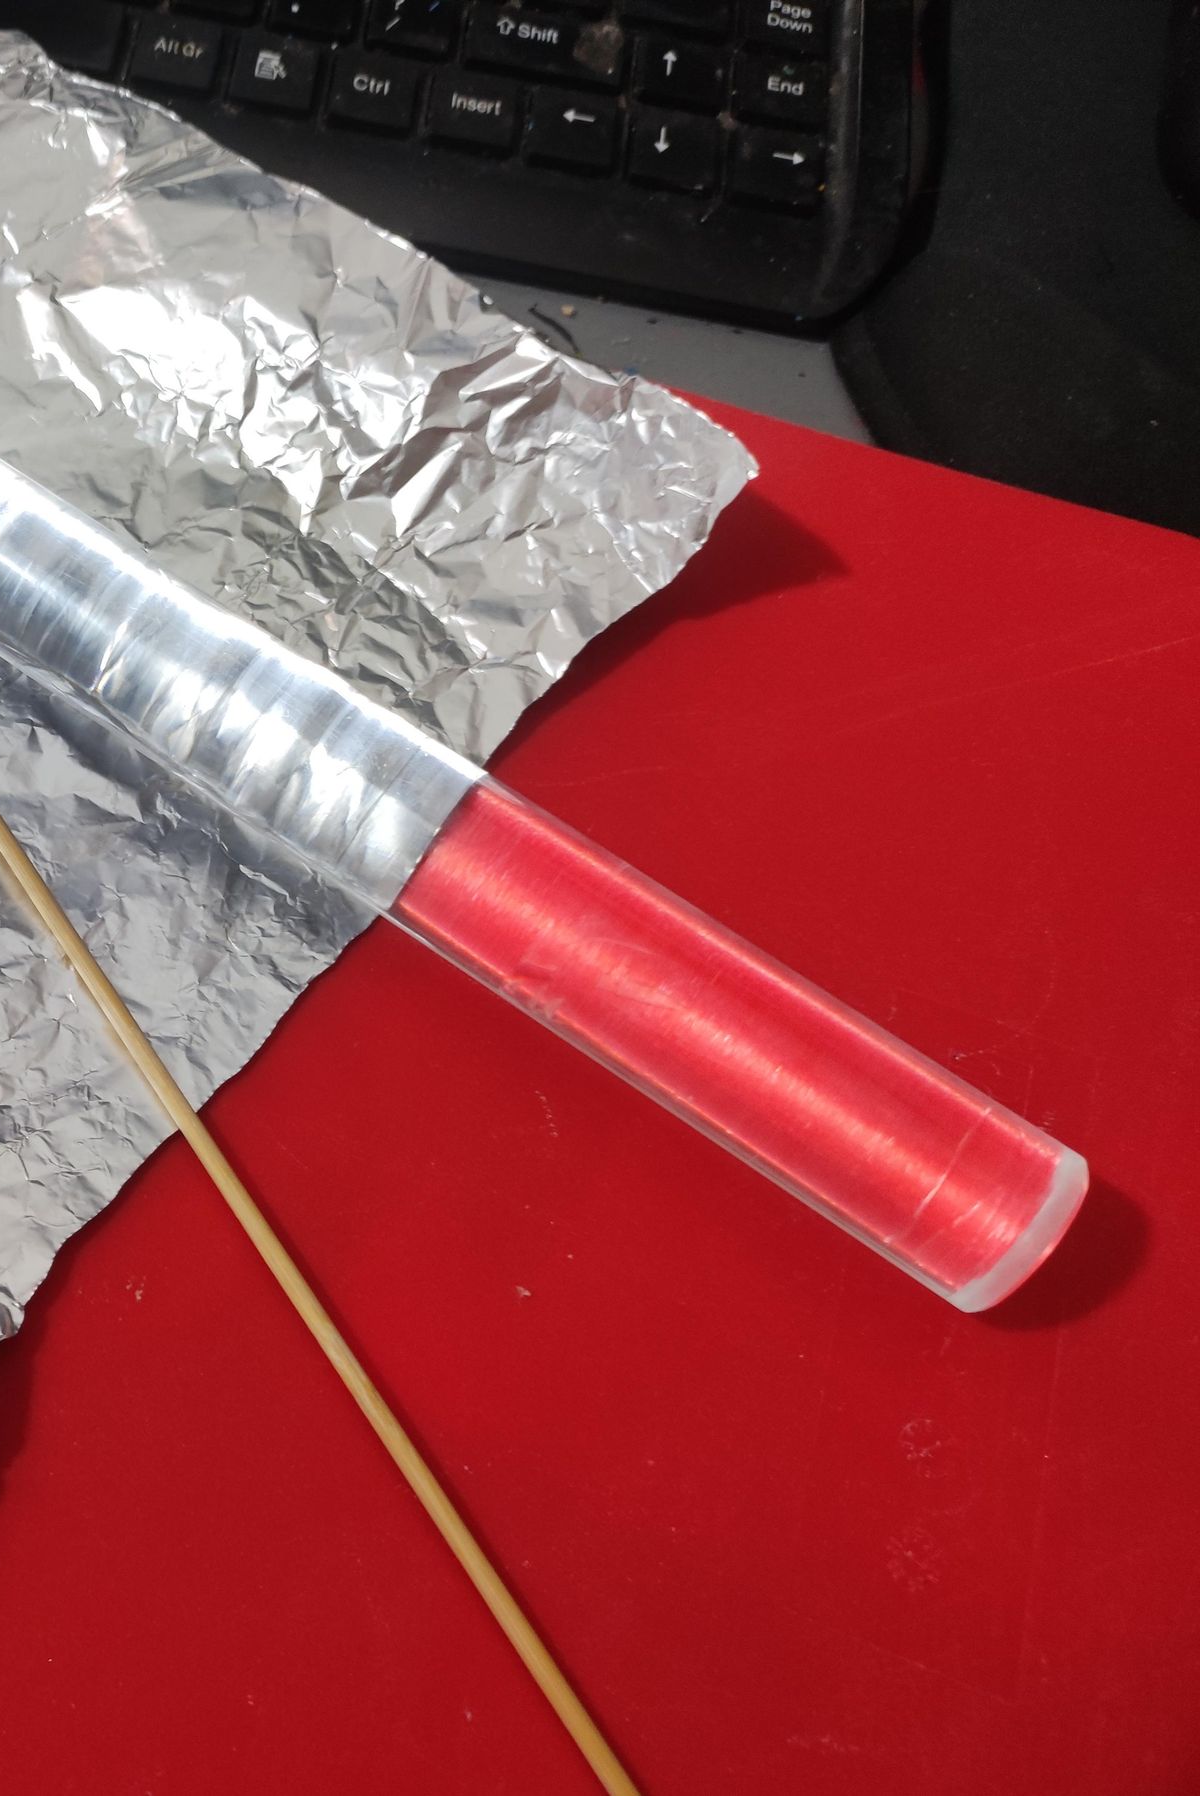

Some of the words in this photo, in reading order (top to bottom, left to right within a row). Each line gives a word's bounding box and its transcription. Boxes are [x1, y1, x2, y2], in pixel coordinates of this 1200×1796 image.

[769, 0, 812, 20] Page
[517, 23, 559, 44] Shift
[767, 13, 813, 34] Down
[154, 36, 180, 54] Alt
[182, 41, 203, 59] Gr
[352, 73, 391, 96] Ctrl
[767, 76, 803, 96] End
[451, 92, 501, 116] Insert
